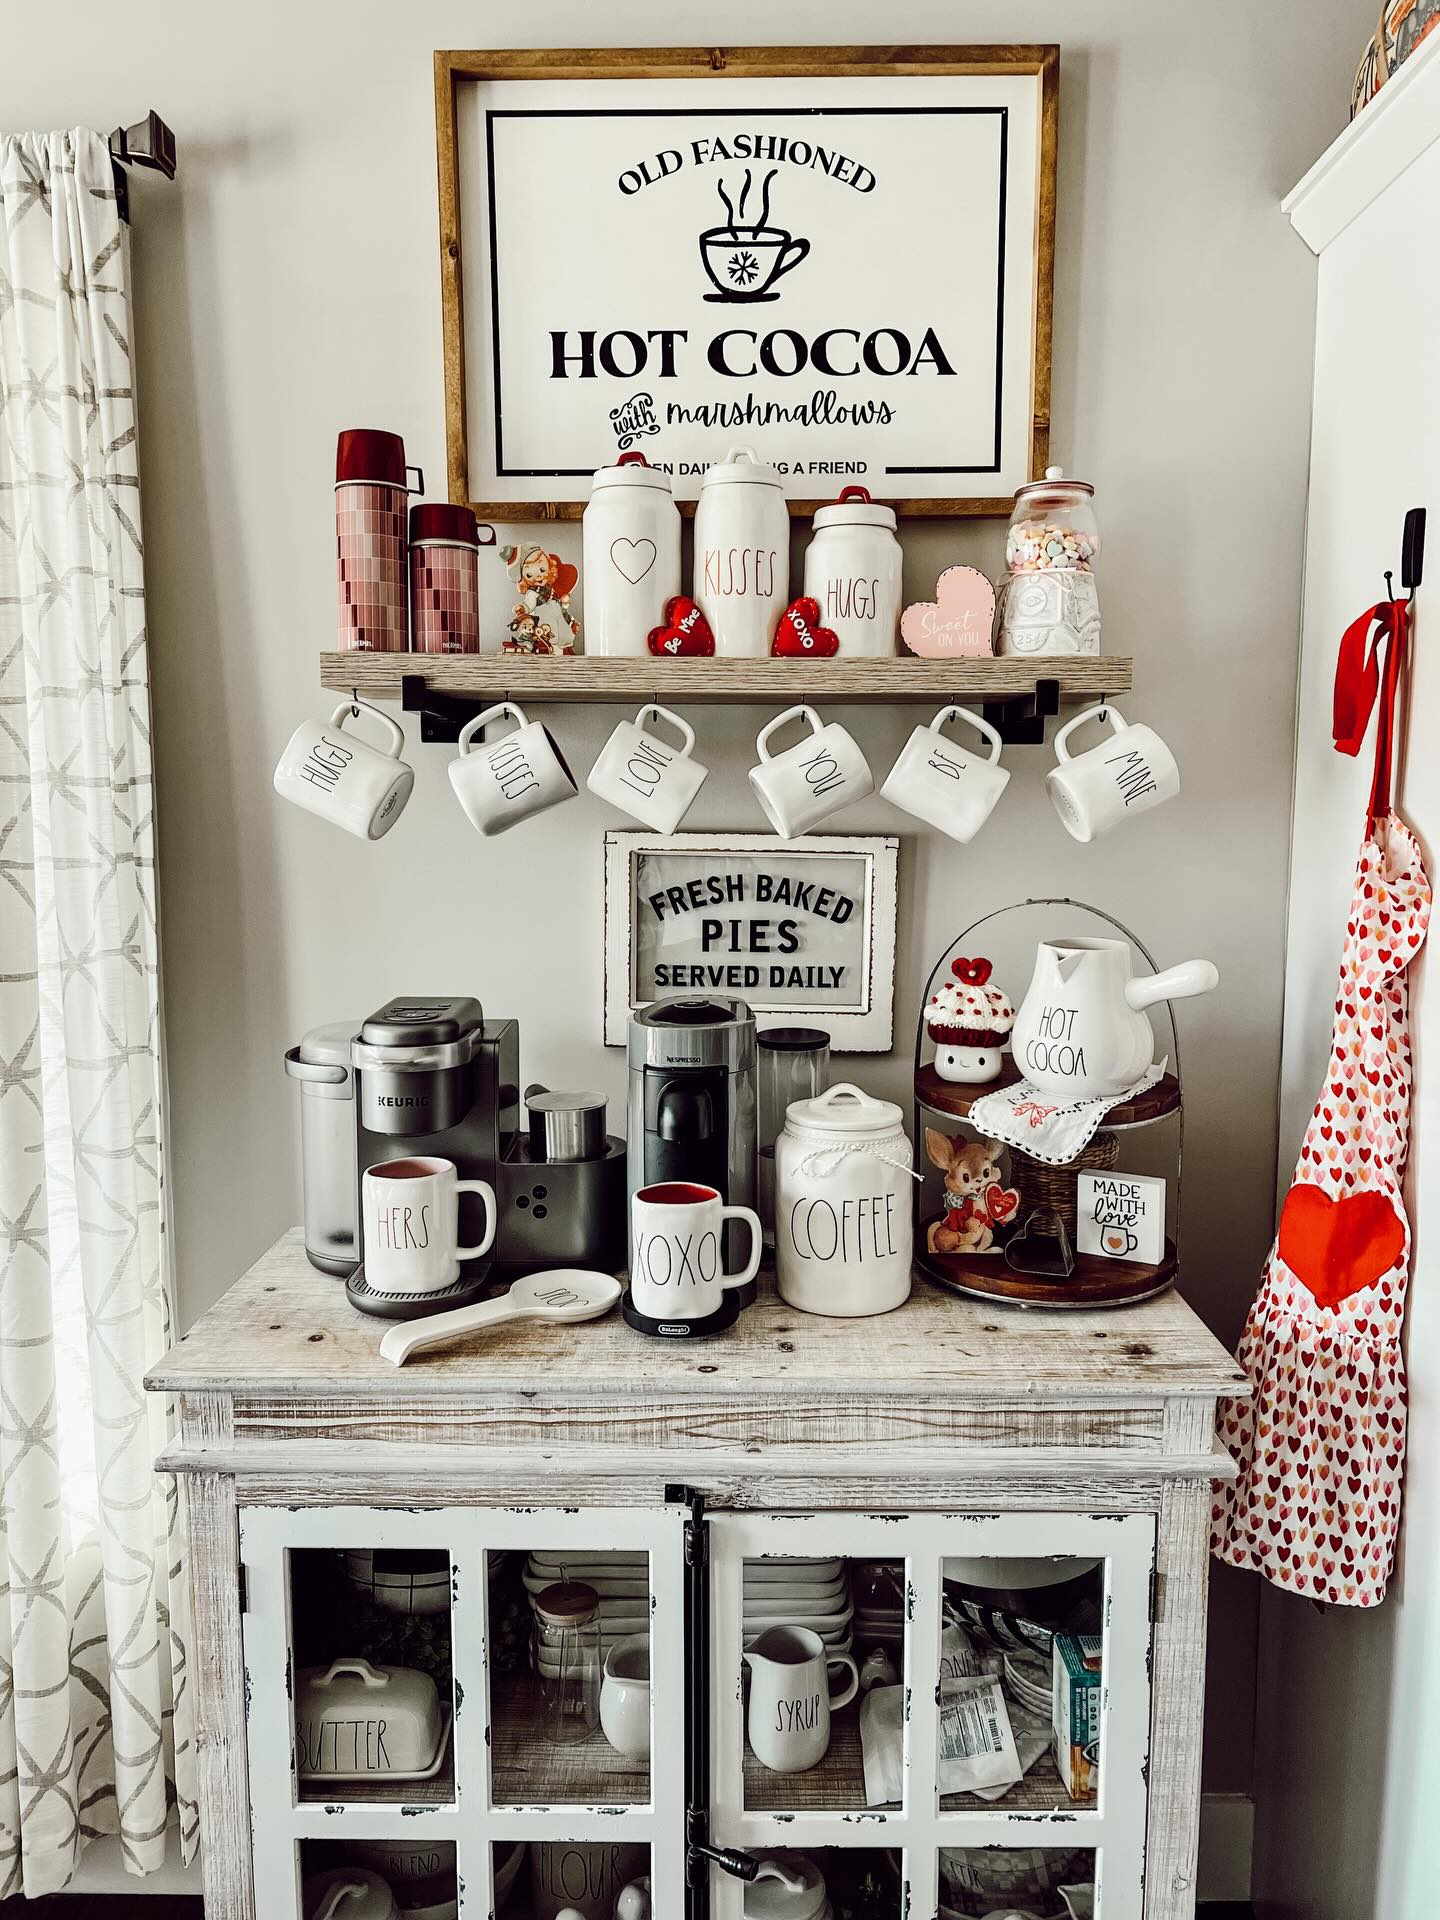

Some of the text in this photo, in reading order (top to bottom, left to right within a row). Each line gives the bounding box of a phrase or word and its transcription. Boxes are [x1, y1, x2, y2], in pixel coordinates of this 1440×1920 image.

[618, 134, 877, 195] OLD FASHIONED
[549, 328, 957, 379] HOT COCOA
[610, 390, 896, 445] with marshmallows
[793, 462, 805, 474] A
[809, 461, 868, 474] FRIEND
[704, 548, 777, 597] KISSES
[827, 579, 879, 619] HUGS
[664, 608, 700, 654] Be Mine
[787, 610, 814, 648] XOXO
[920, 610, 976, 638] Sweet
[938, 632, 979, 647] ON YOU
[300, 736, 353, 793] HUGS
[487, 739, 540, 800] KISSES
[619, 740, 674, 798] LOVE
[799, 749, 845, 797] YOU
[928, 749, 967, 780] BE
[1105, 751, 1159, 806] MINE
[648, 874, 854, 924] FRESH BAKED
[701, 919, 799, 953] PIES
[654, 964, 845, 988] SERVED DAILY
[1039, 1005, 1079, 1040] HOT
[1025, 1040, 1087, 1076] COCOA
[378, 1096, 429, 1107] KEURIG
[1093, 1179, 1141, 1199] MADE
[1105, 1197, 1146, 1215] WITH
[376, 1205, 430, 1250] HERS
[791, 1194, 898, 1263] COFFEE
[1090, 1197, 1138, 1226] love
[633, 1232, 717, 1286] XOXO
[775, 1694, 820, 1732] SYRUP
[389, 1853, 440, 1875] BLEND
[950, 1861, 985, 1889] STIR
